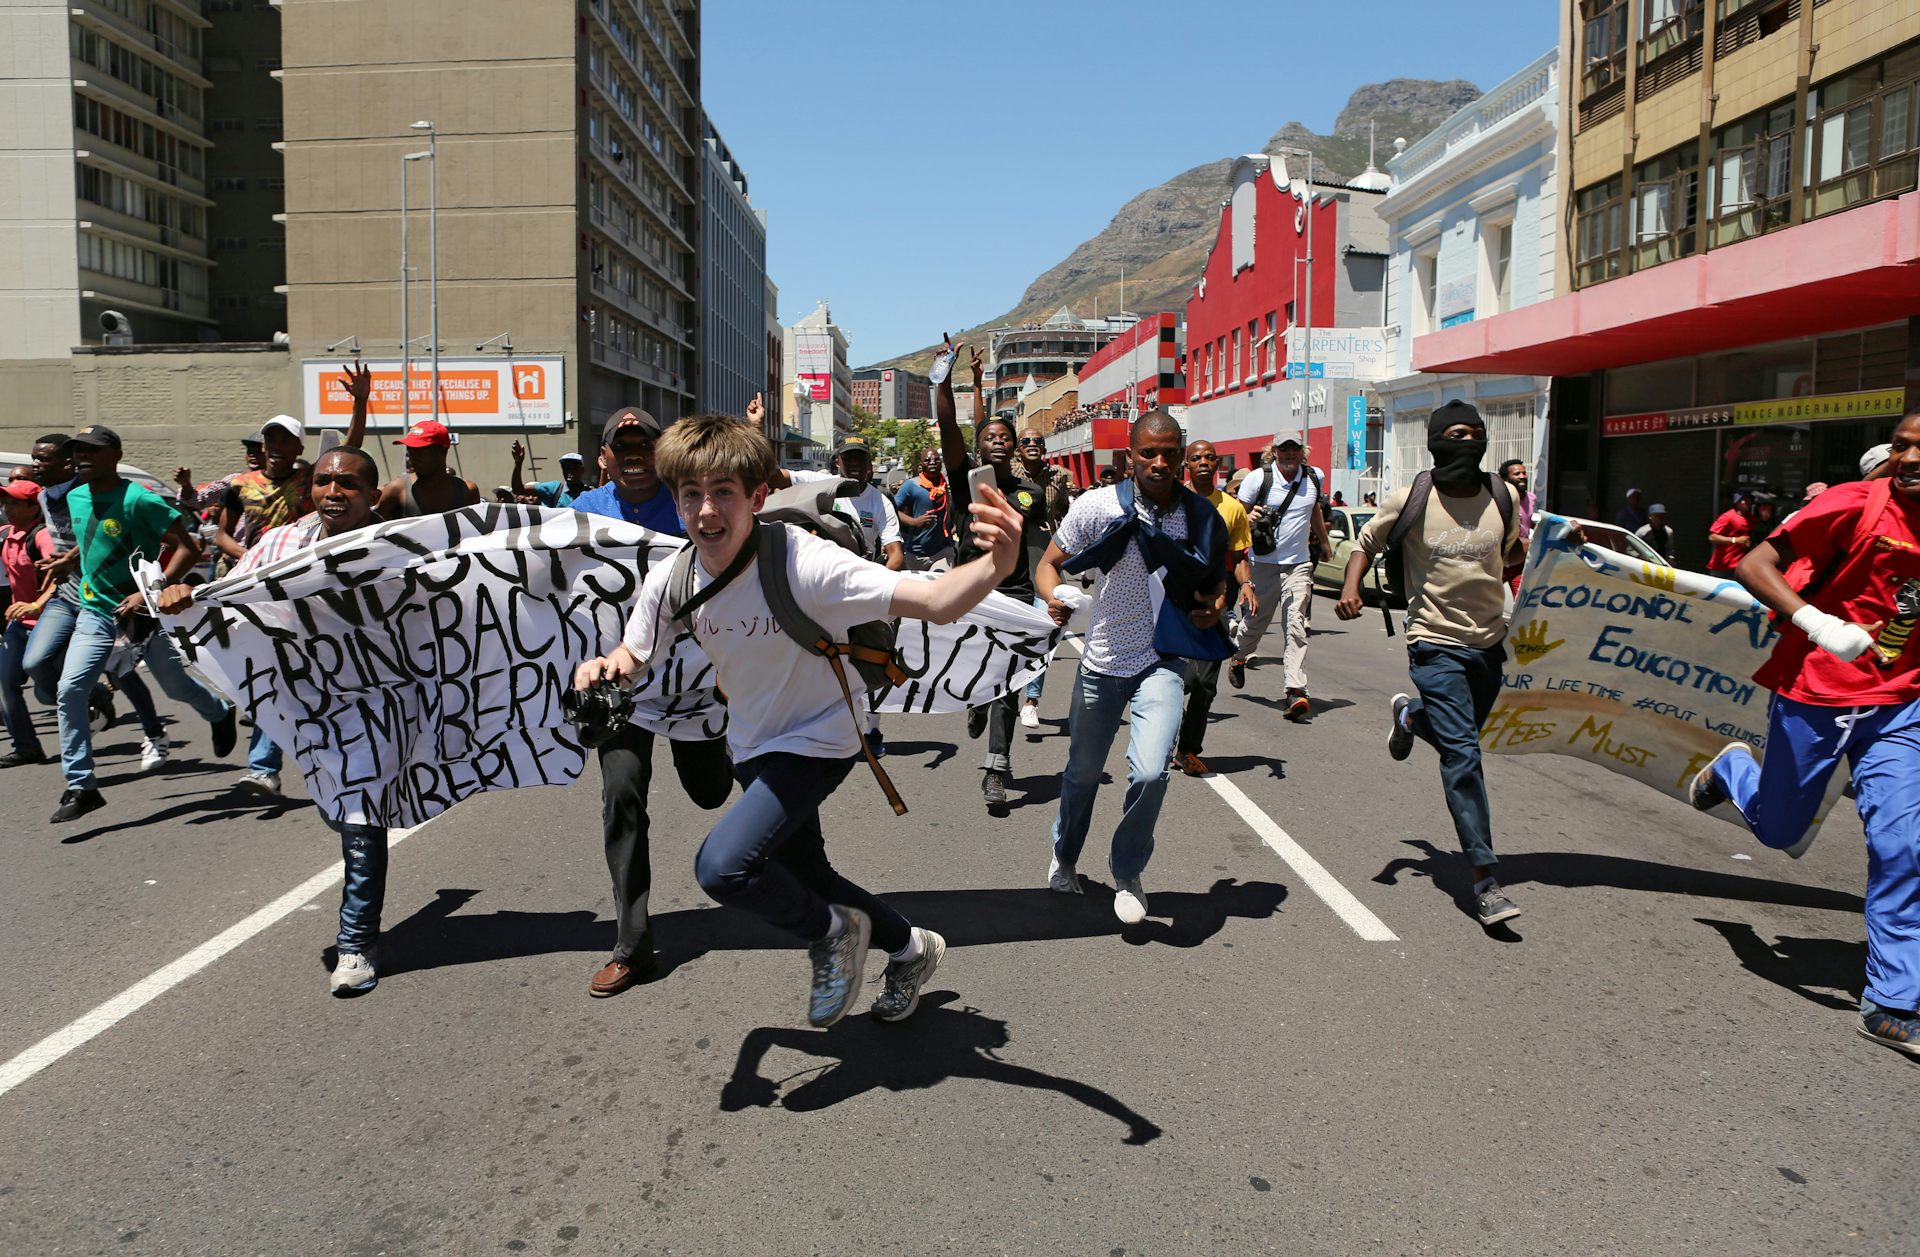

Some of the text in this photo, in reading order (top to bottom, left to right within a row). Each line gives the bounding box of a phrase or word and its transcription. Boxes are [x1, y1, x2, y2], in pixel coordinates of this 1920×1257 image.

[1292, 333, 1382, 353] CARPENTER'S
[1358, 355, 1377, 365] Shop
[373, 380, 405, 390] BECAUS
[412, 380, 432, 390] THEY
[438, 379, 480, 390] PECIALISE
[481, 379, 491, 389] IN
[327, 391, 350, 401] HOME
[381, 391, 401, 400] THEY
[408, 391, 428, 400] ON'T
[446, 390, 475, 400] THINGS
[477, 390, 490, 400] UP.
[1606, 420, 1649, 432] KARATE
[1669, 411, 1729, 427] FITNESS
[1735, 408, 1772, 420] DANCE
[1351, 399, 1363, 467] Car Wash
[1632, 696, 1697, 722] #CPUT
